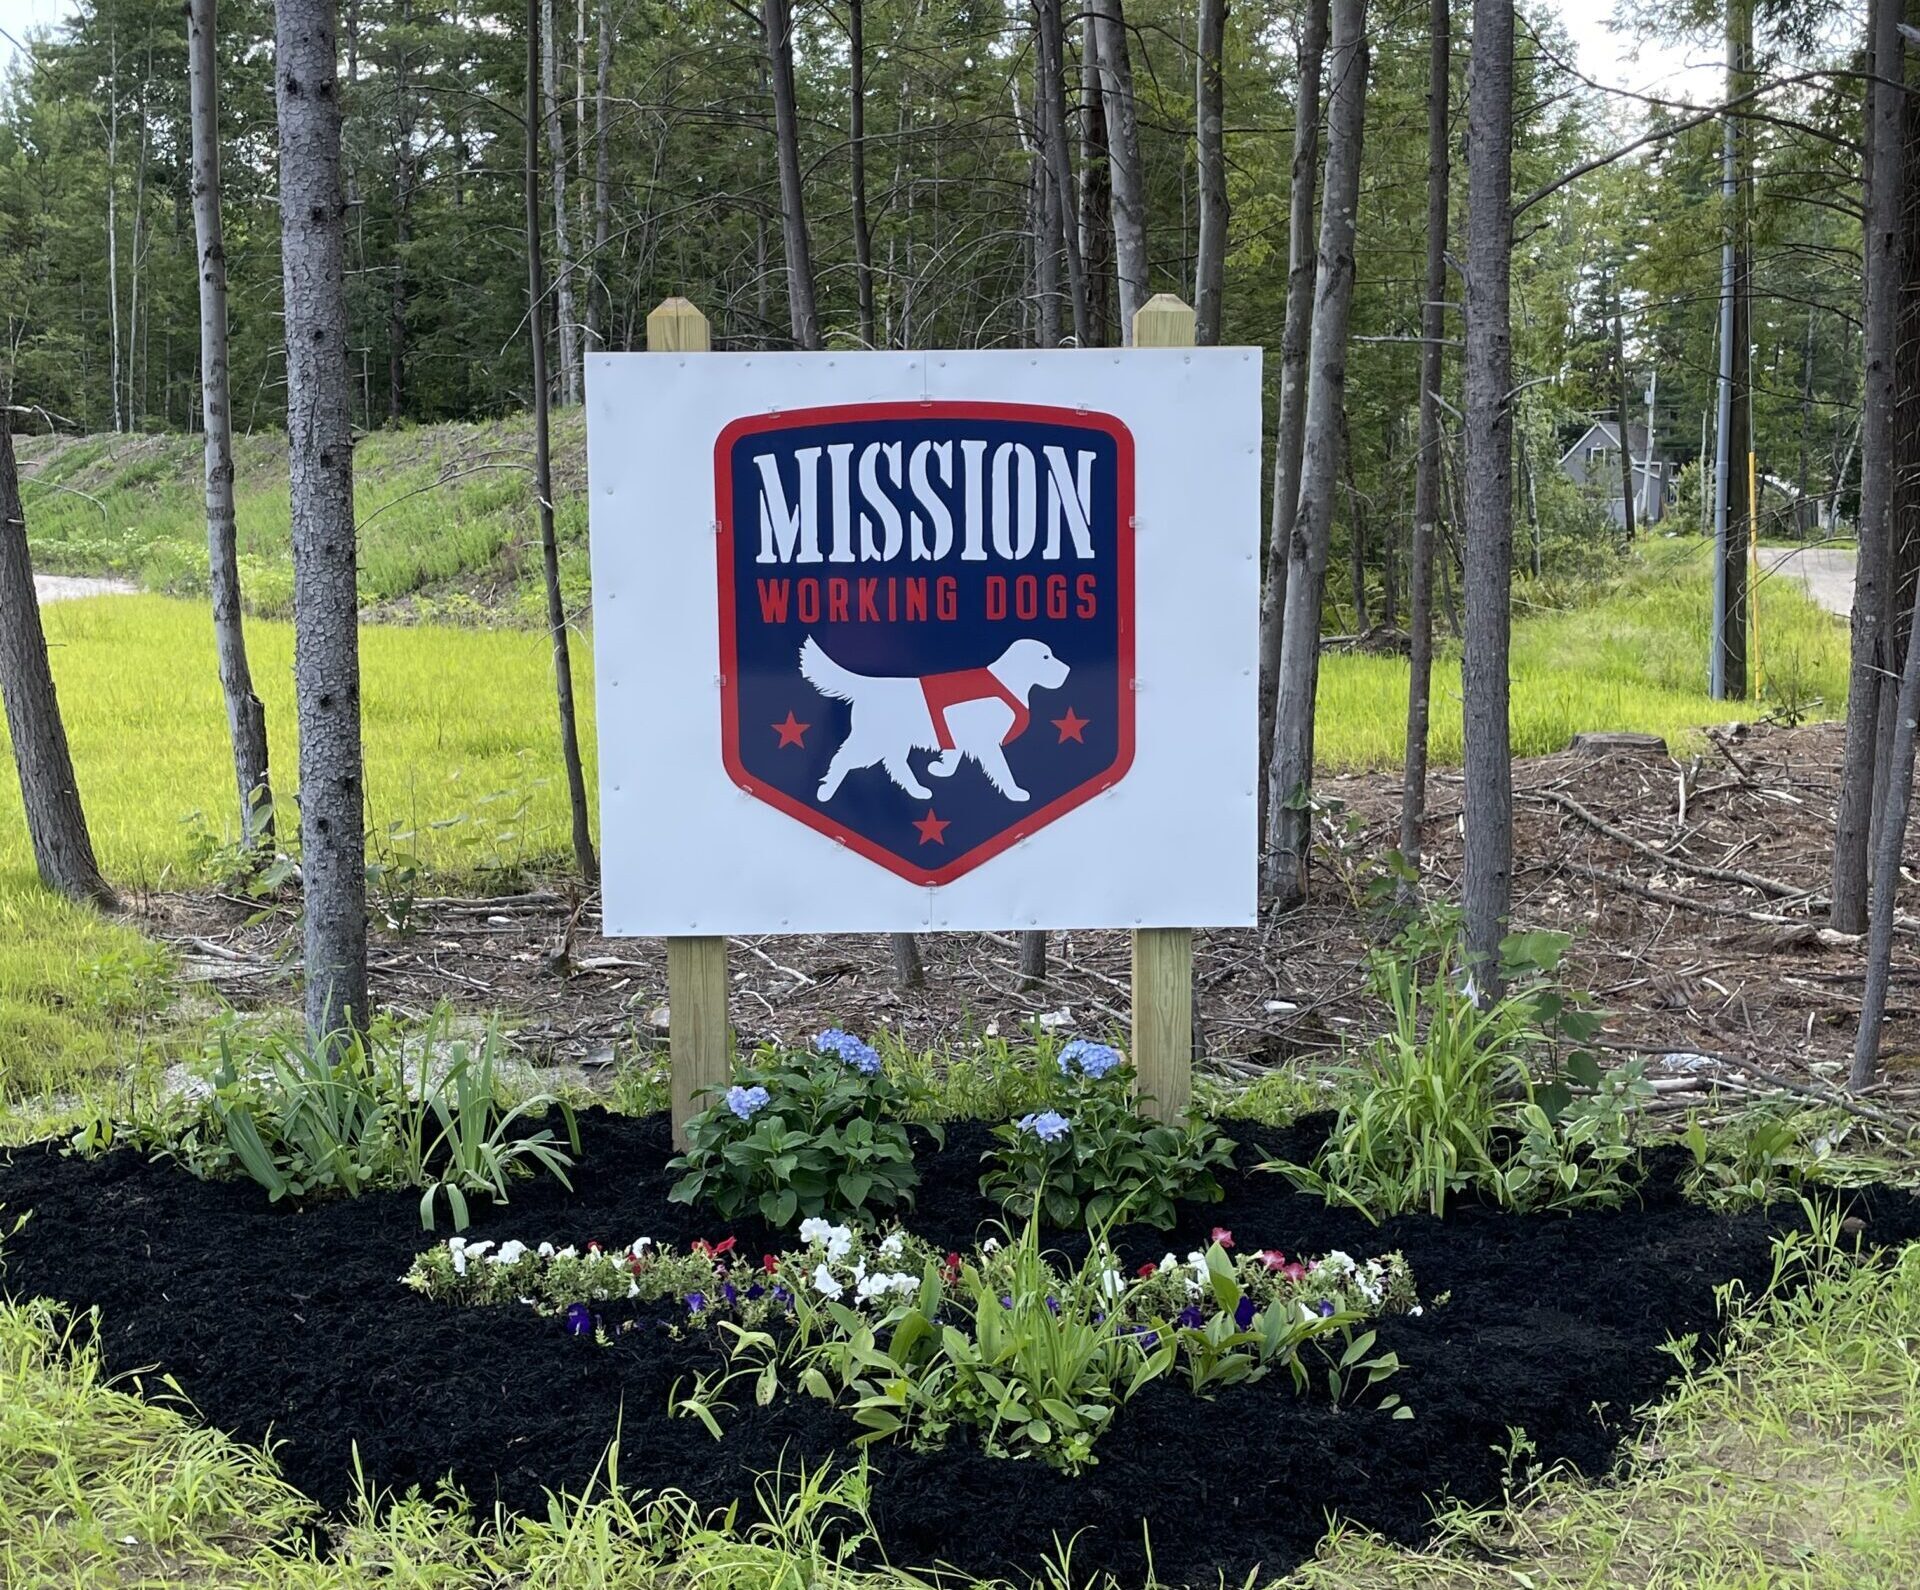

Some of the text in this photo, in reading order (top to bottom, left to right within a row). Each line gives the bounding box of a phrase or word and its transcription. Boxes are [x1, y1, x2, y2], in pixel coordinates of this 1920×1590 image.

[753, 440, 1096, 563] MISSION
[757, 574, 1096, 623] WORKING DOGS
